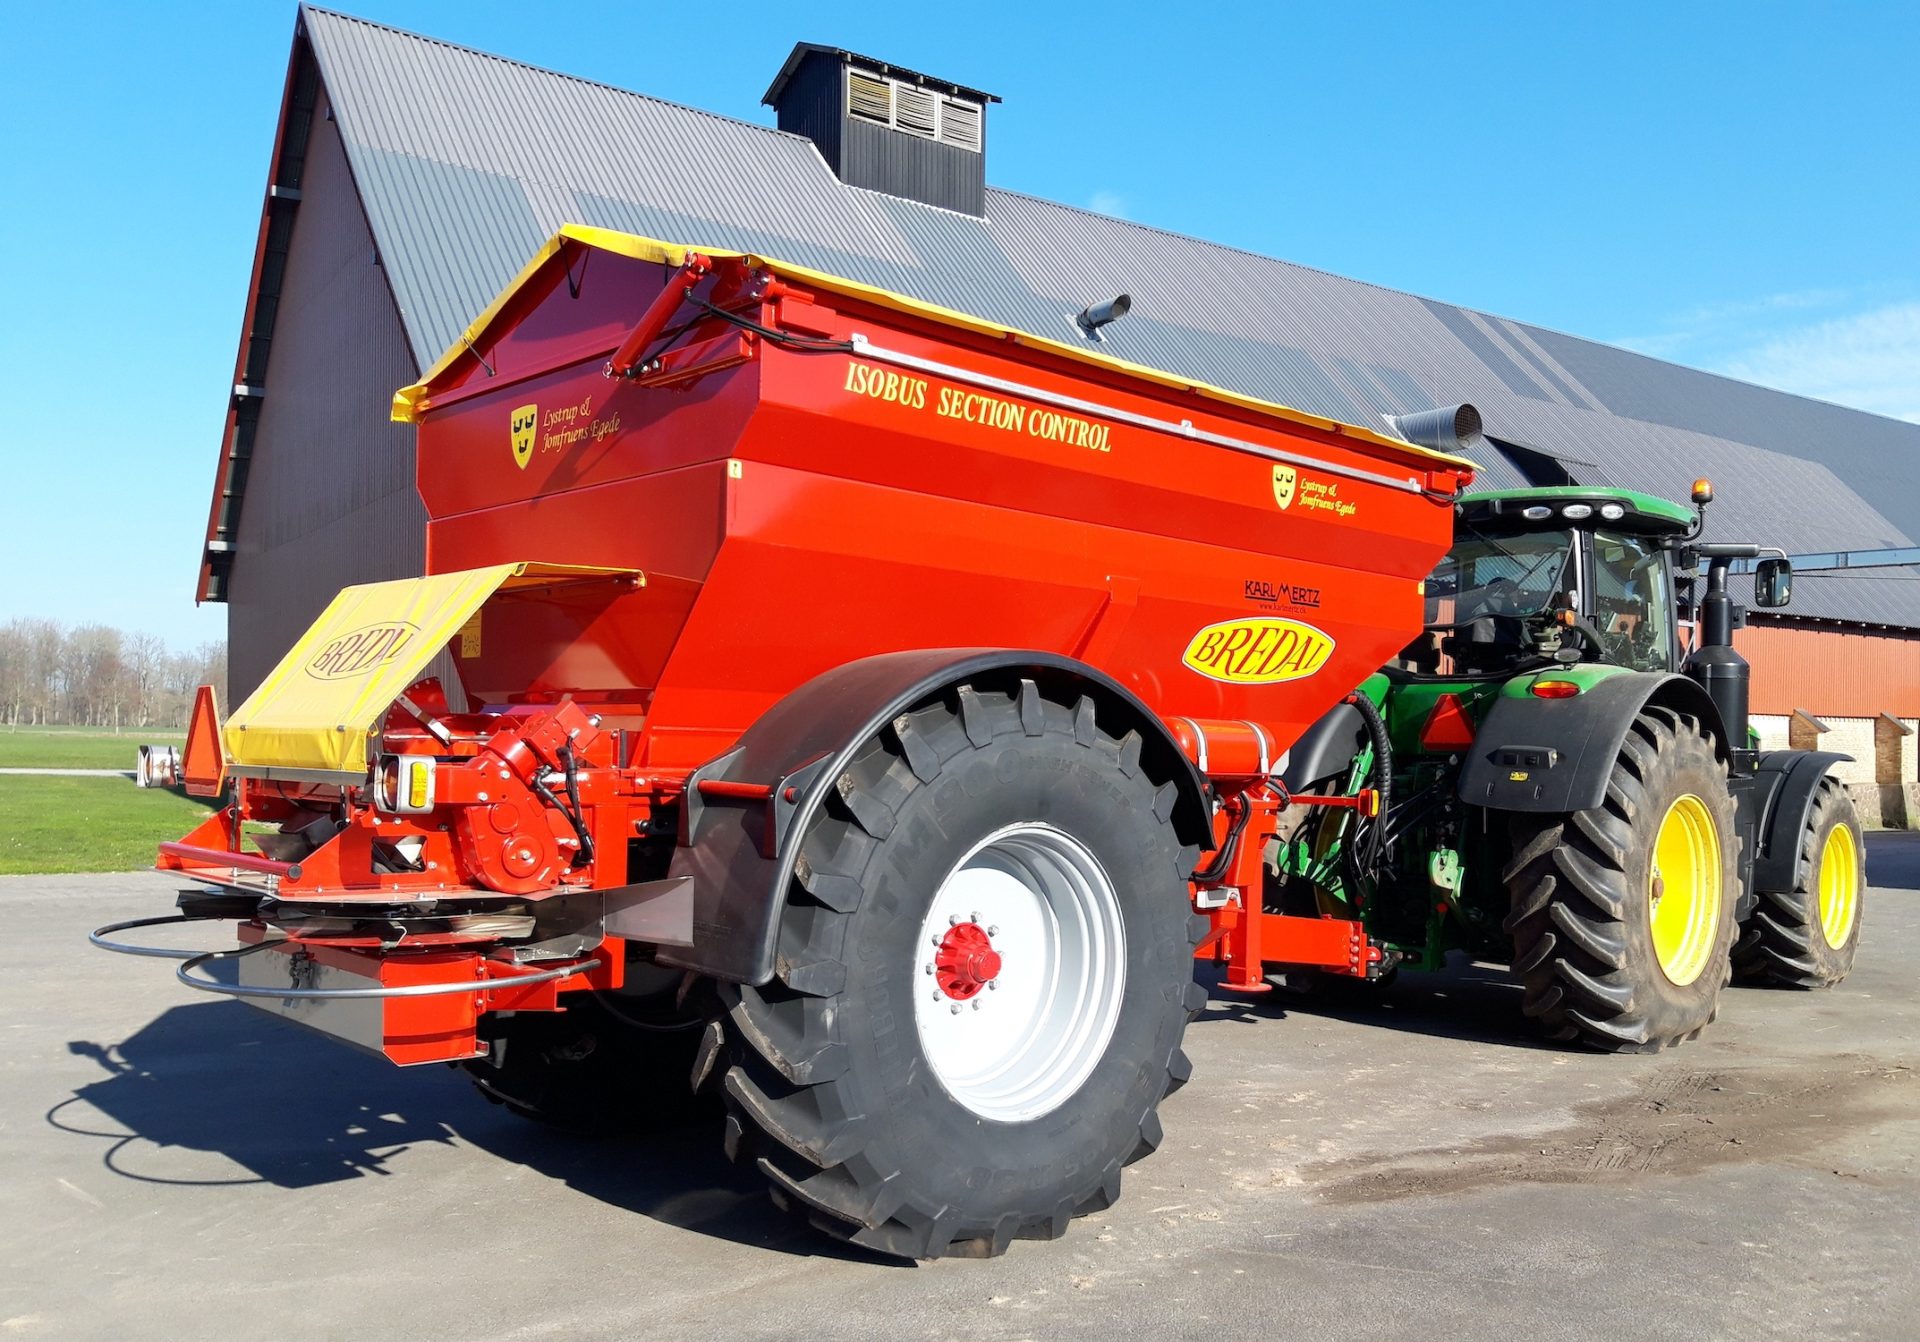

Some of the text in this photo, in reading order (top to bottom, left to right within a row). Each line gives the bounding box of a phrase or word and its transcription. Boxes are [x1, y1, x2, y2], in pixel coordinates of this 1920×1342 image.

[543, 395, 592, 431] Lystrup &
[844, 362, 1111, 452] ISOBUS SECTION CONTROL
[541, 412, 621, 453] Jomfruens Egede
[1300, 478, 1328, 497] Lystrup
[1335, 501, 1356, 516] Egede
[1245, 580, 1320, 603] KARL MERTZ
[313, 628, 413, 676] BREDAL
[1193, 627, 1325, 676] BREDAL
